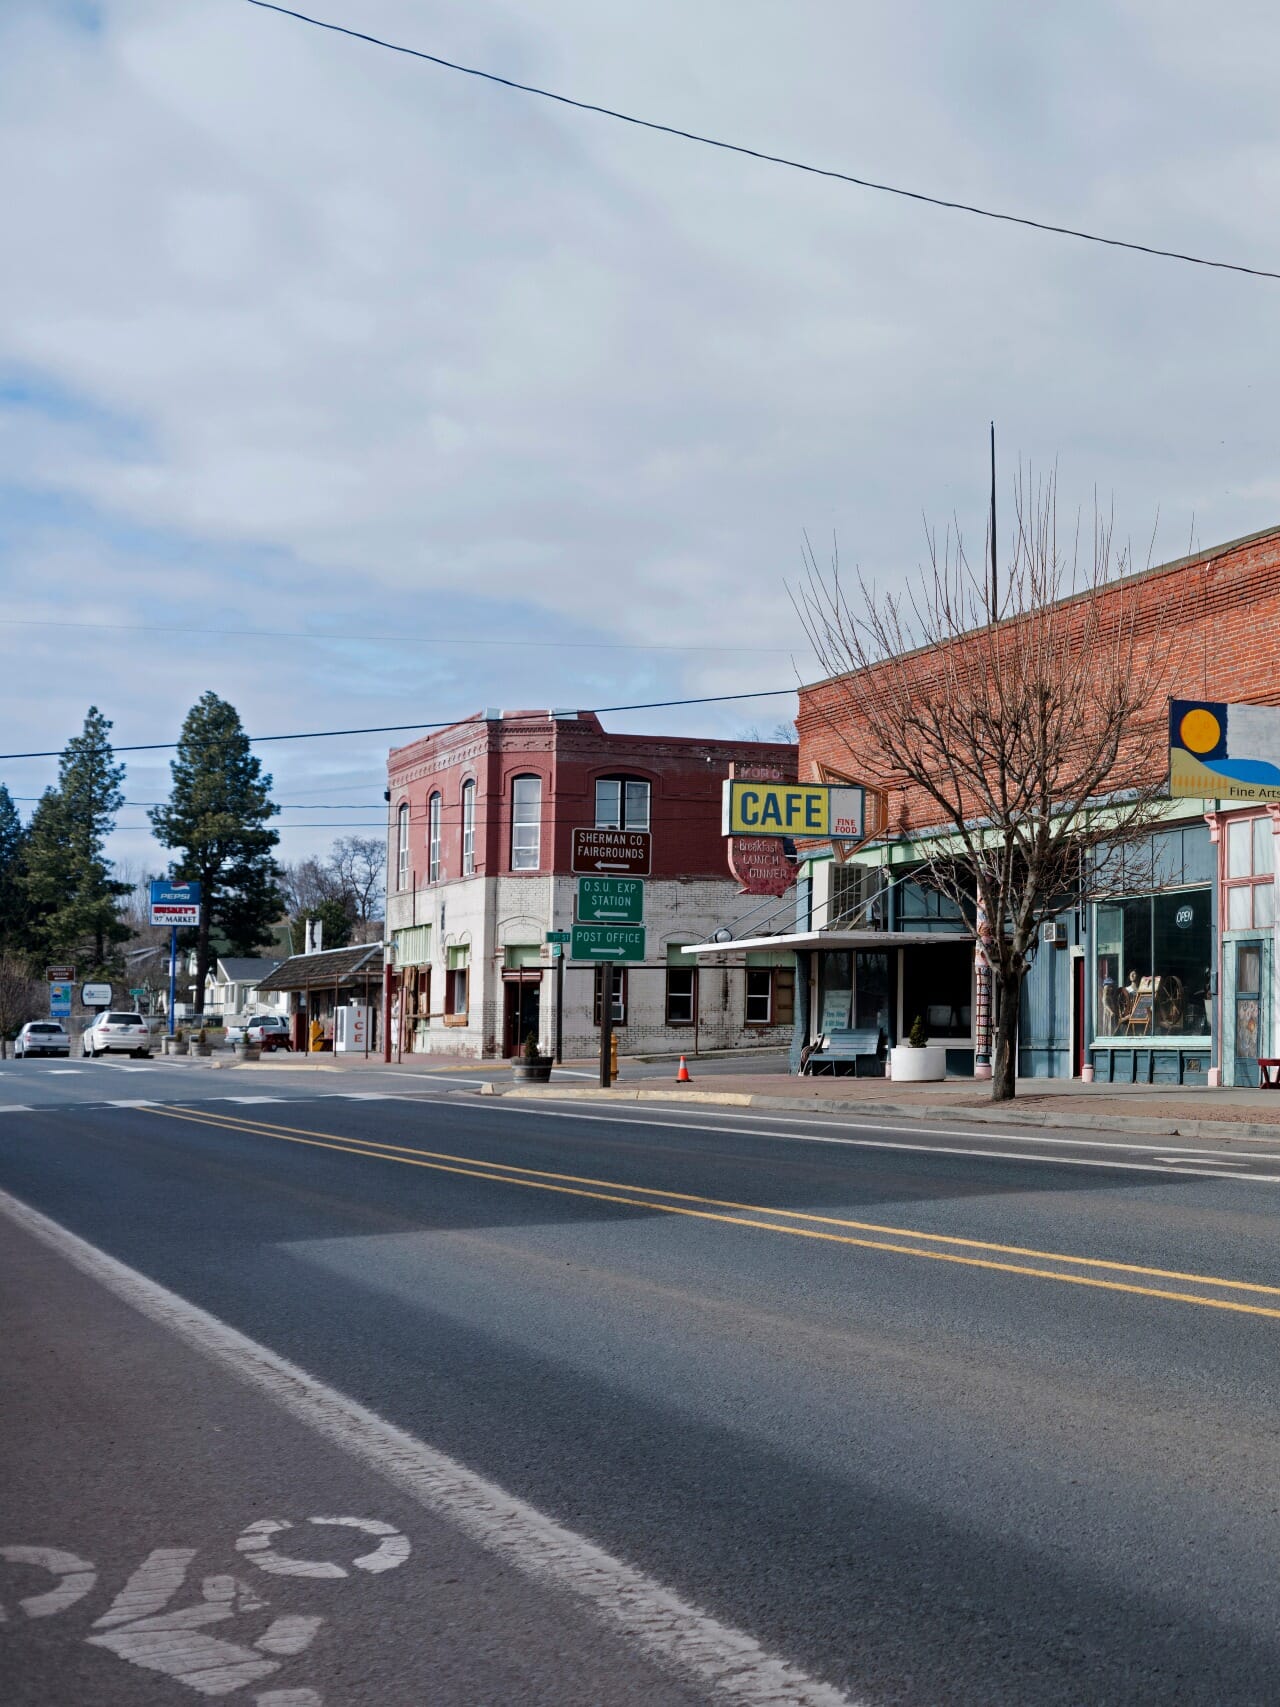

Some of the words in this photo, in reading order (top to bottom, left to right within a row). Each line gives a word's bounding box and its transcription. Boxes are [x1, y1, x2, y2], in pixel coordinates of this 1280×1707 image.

[1229, 786, 1255, 798] Fine
[741, 791, 822, 828] CAFE
[837, 818, 855, 826] FINE
[835, 825, 857, 834] FOOD
[579, 832, 626, 845] SHERMAN
[630, 835, 646, 846] CO.
[577, 845, 644, 859] FAIRGROUNDS
[743, 854, 779, 865] LUNCH
[749, 868, 787, 879] DINNER
[591, 895, 631, 907] STATION
[1176, 911, 1193, 923] OPEN
[576, 931, 602, 942] POST
[606, 932, 641, 943] OFFICE
[353, 1010, 364, 1043] ICE
